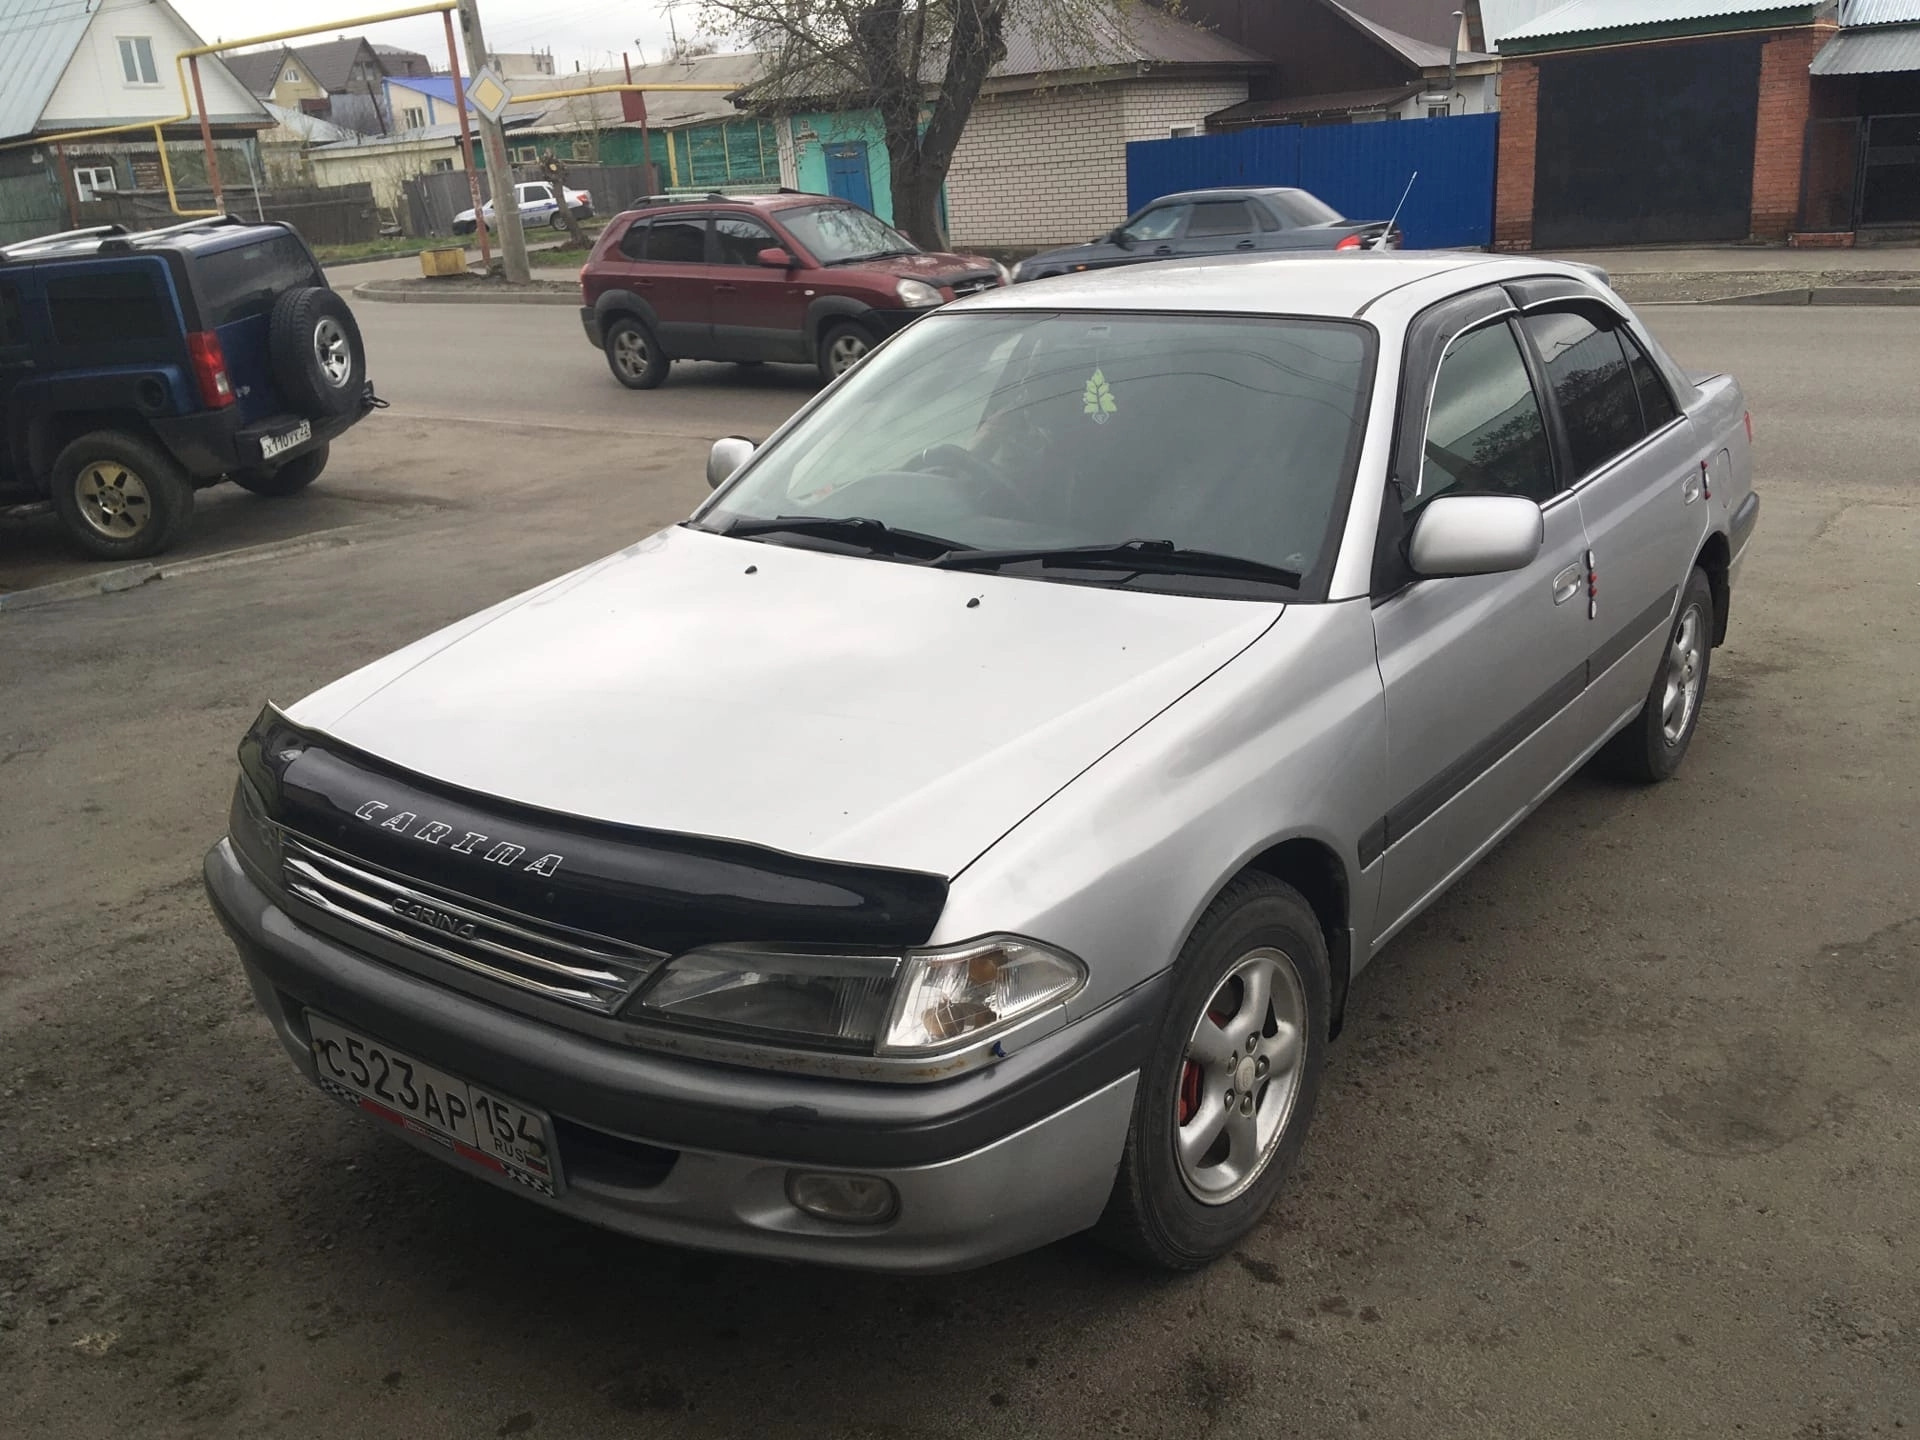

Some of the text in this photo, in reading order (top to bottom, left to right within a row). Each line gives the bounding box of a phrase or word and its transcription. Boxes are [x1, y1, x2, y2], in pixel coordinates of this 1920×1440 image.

[354, 800, 564, 877] CARINA
[391, 898, 477, 940] CARINA
[323, 1036, 546, 1157] C523AP 154
[493, 1136, 525, 1164] RUS
